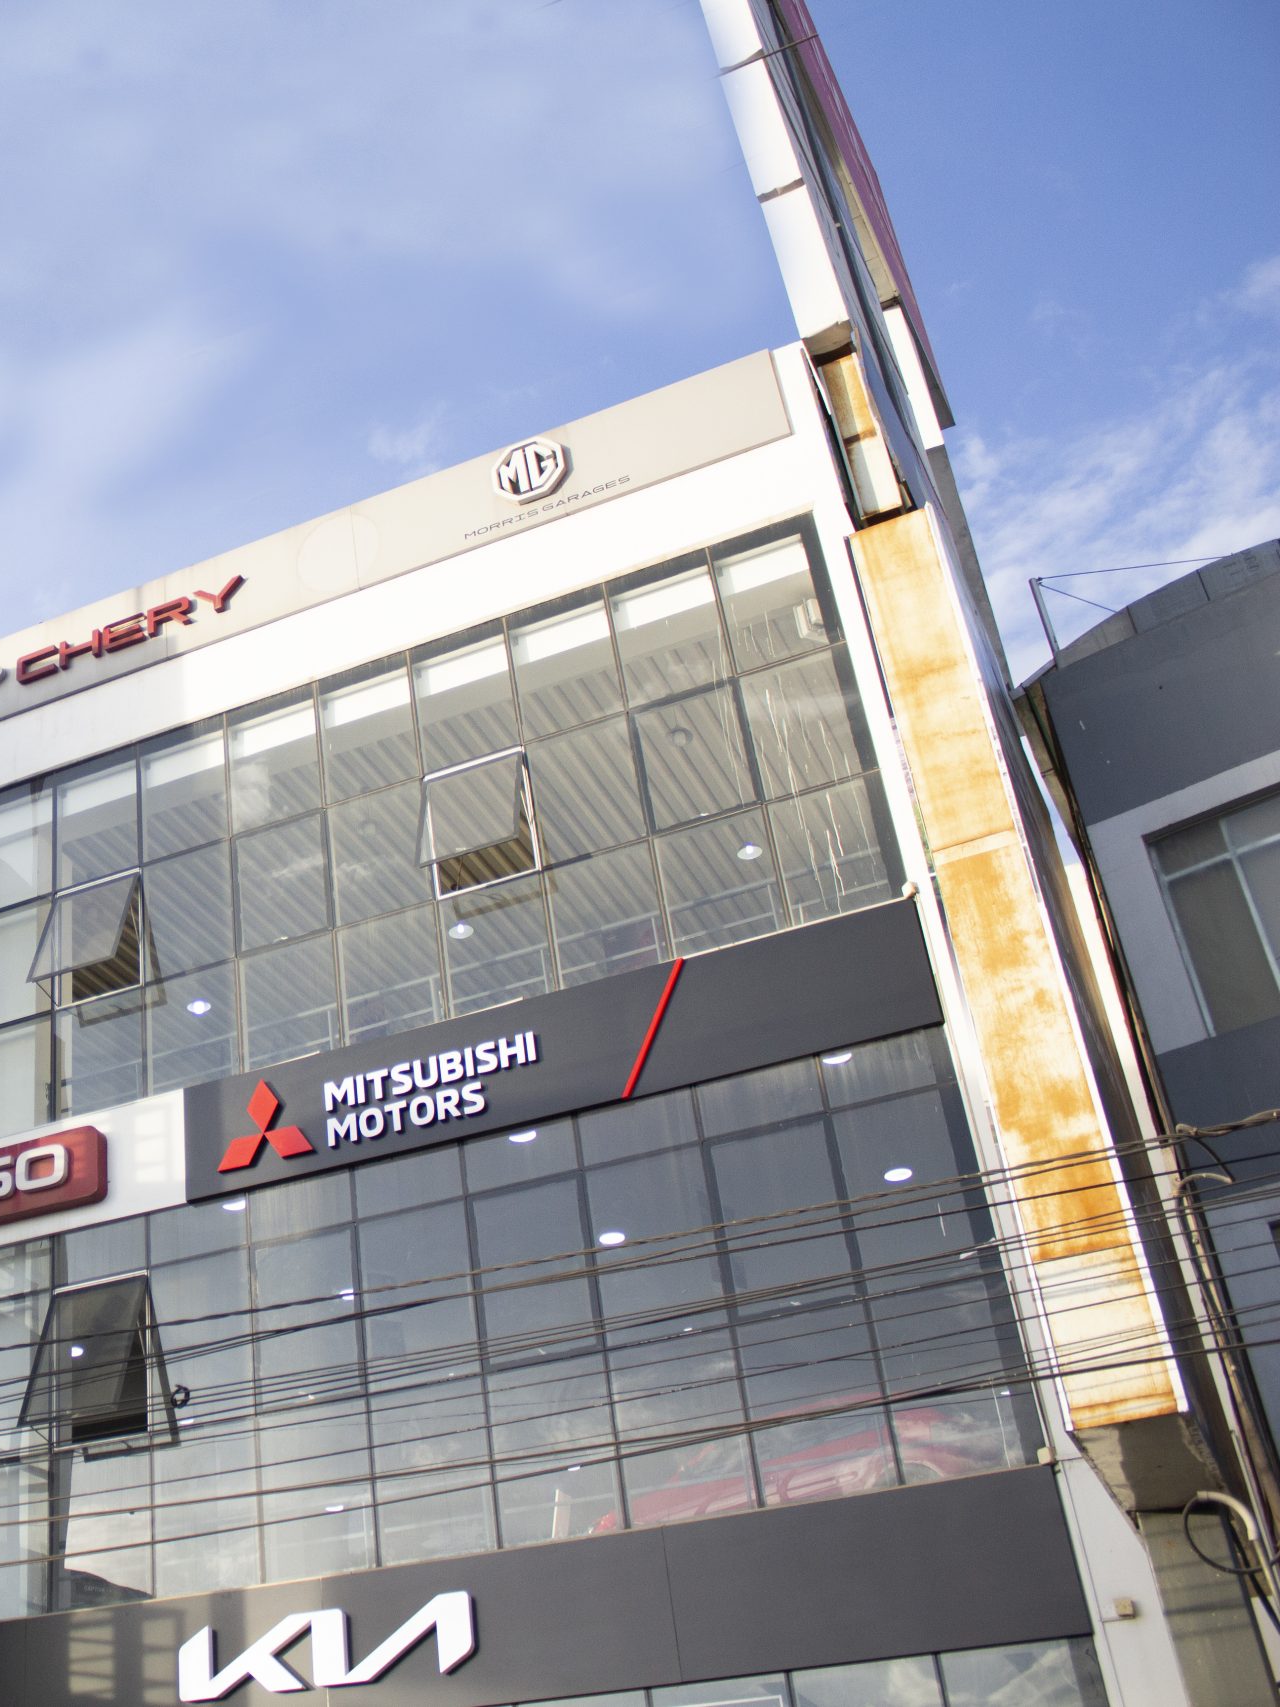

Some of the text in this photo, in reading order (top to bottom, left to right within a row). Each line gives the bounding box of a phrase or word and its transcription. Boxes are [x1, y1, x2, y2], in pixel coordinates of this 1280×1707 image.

[499, 441, 557, 494] MG
[464, 475, 631, 540] MORRIS GARAGES
[16, 574, 245, 684] CHERY
[324, 1031, 538, 1111] MITSUBISHI
[327, 1082, 486, 1147] MOTORS
[178, 1590, 474, 1702] KIA
